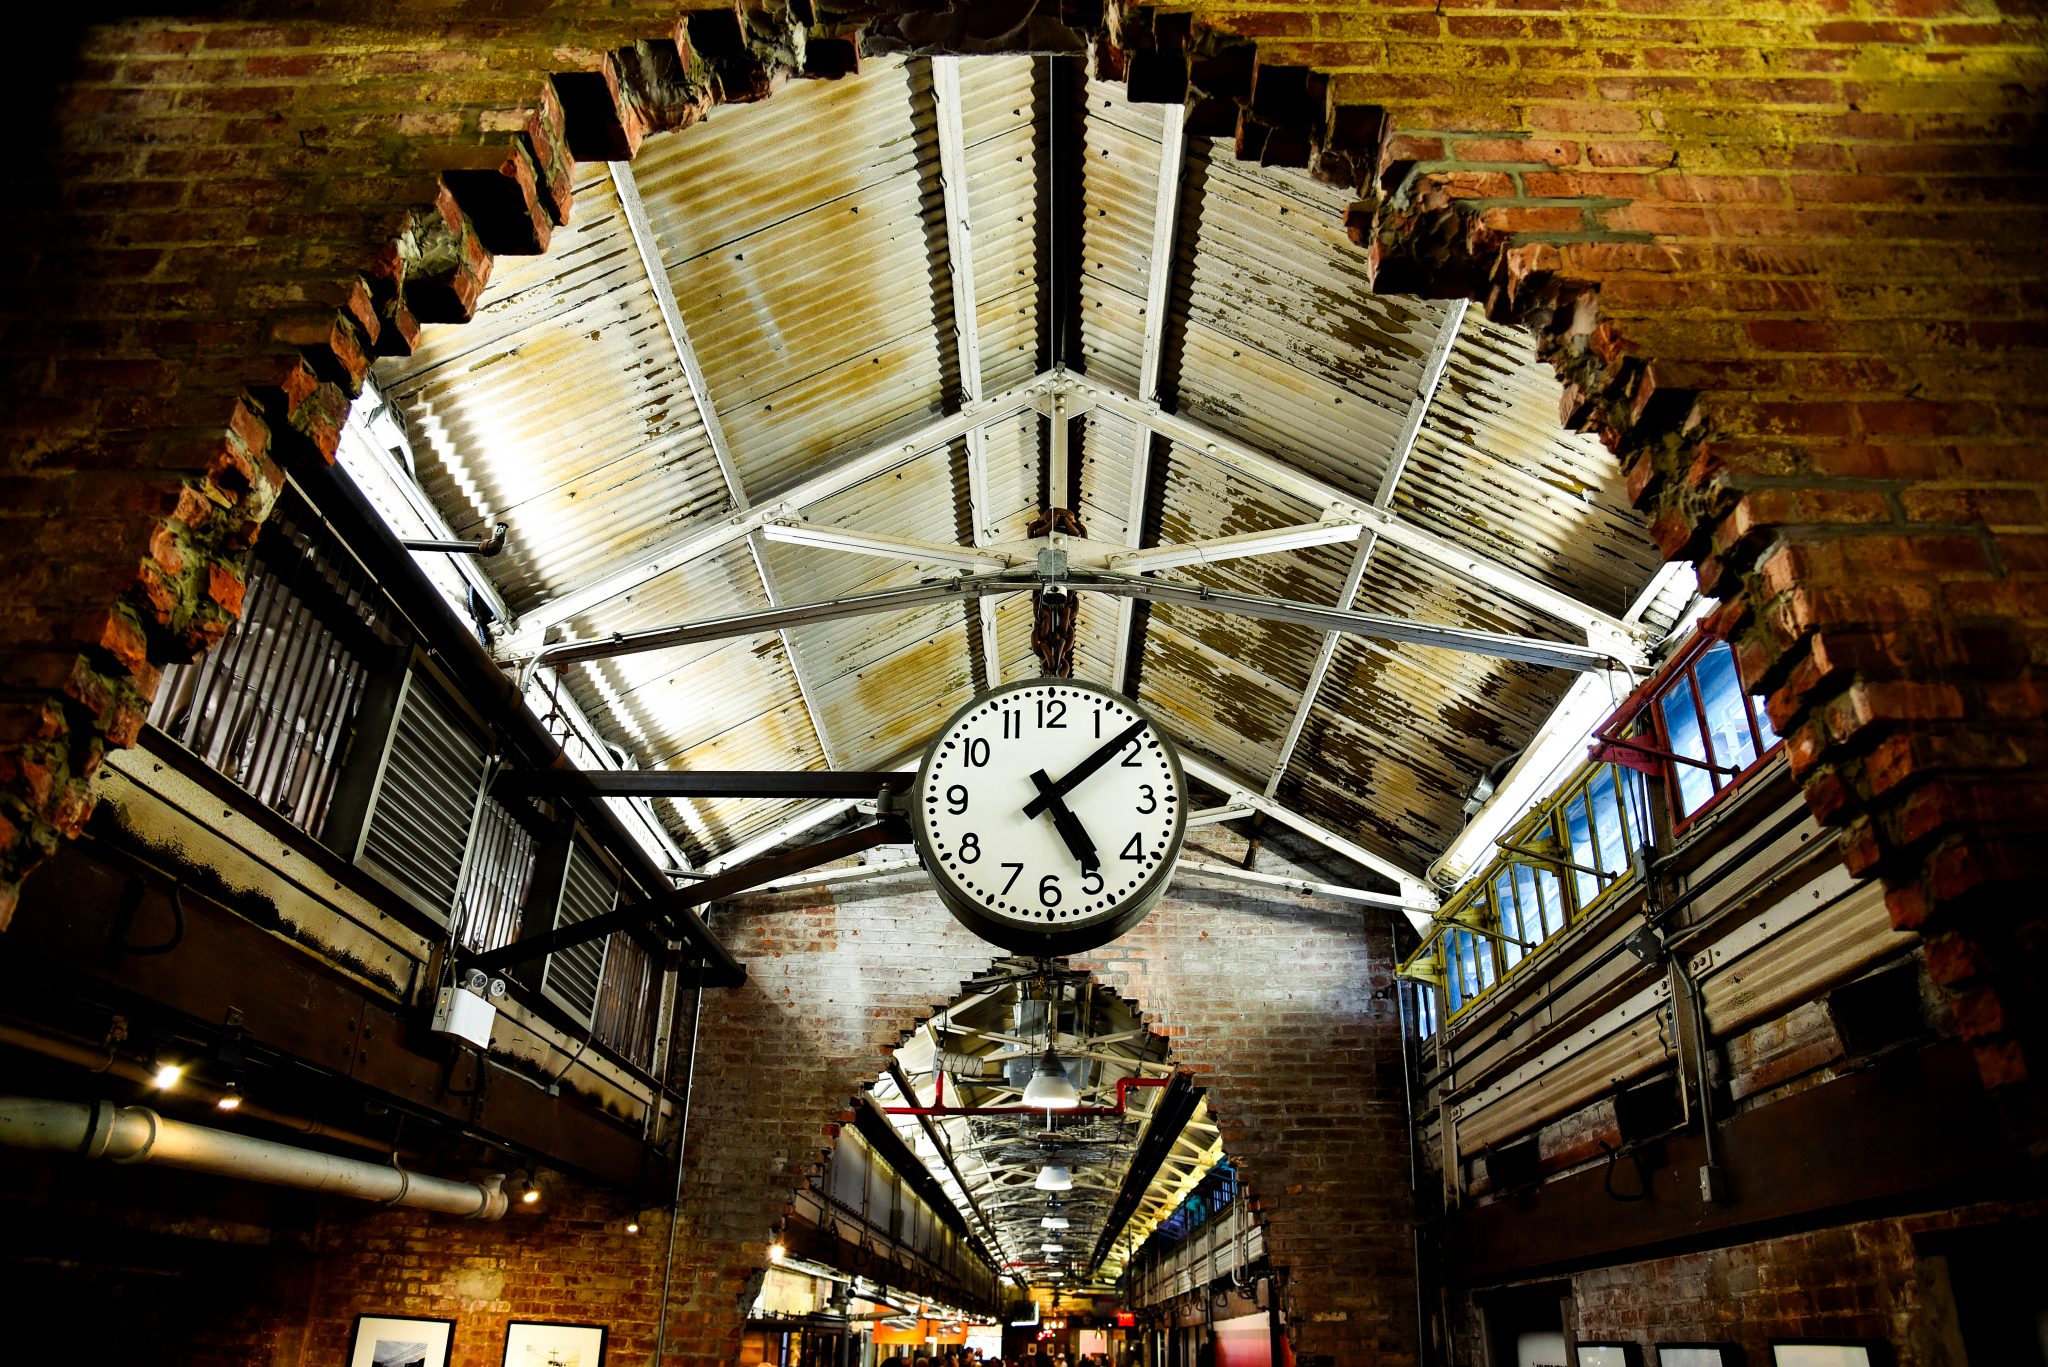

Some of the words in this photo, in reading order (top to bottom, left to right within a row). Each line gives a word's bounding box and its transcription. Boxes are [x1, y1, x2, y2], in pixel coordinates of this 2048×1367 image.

[1003, 710, 1020, 739] 11
[1037, 700, 1066, 728] 12
[1093, 710, 1100, 738] 1
[963, 738, 990, 767] 10
[1121, 738, 1142, 767] 2
[947, 785, 968, 815] 9
[1136, 785, 1156, 814] 3
[959, 833, 980, 864] 8
[1120, 832, 1147, 865] 4
[1001, 863, 1023, 895] 7
[1039, 875, 1062, 907] 6
[1081, 862, 1104, 895] 5
